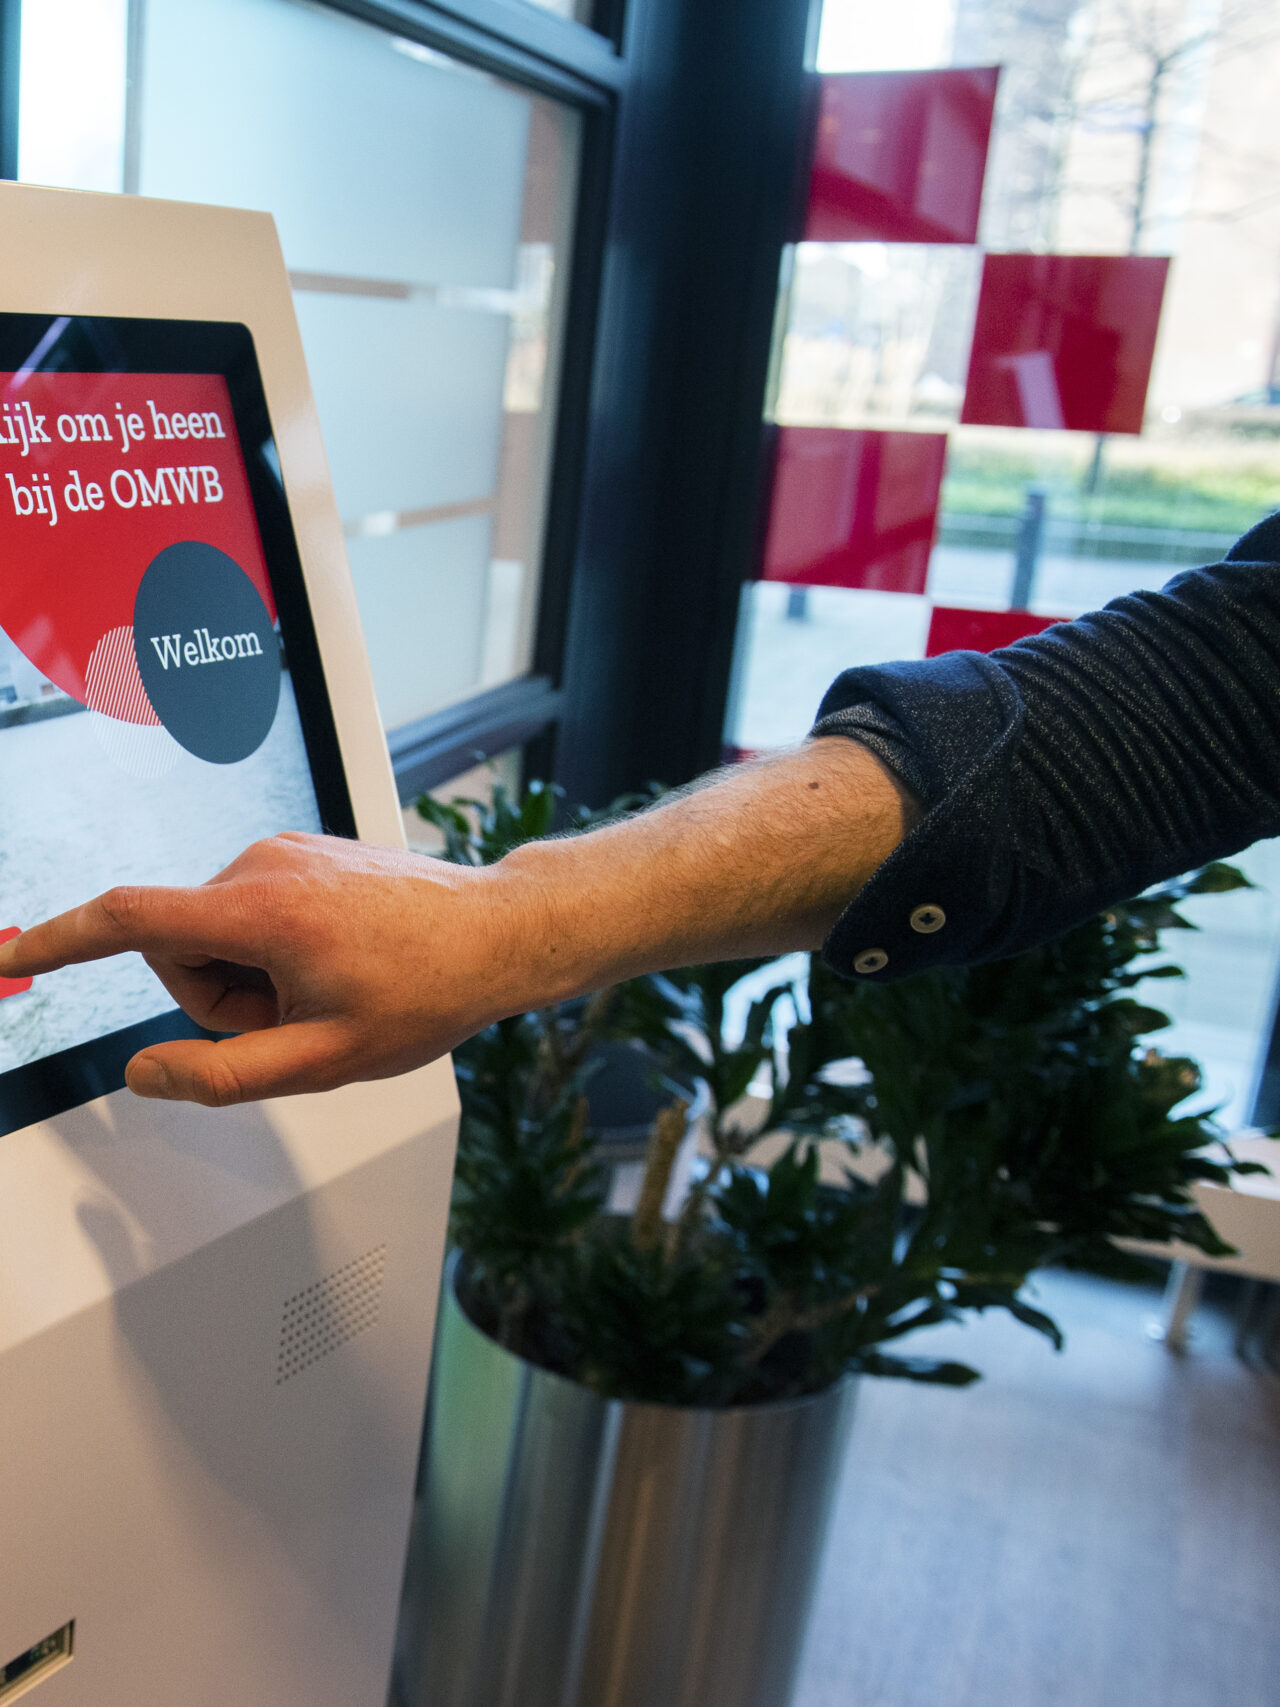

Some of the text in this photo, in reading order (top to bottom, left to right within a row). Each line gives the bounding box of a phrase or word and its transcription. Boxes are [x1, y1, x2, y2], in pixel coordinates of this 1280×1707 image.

[57, 410, 113, 444] om
[115, 402, 146, 453] je
[147, 400, 226, 440] heen
[5, 465, 224, 527] bij de OMWB
[150, 628, 263, 670] Welkom
